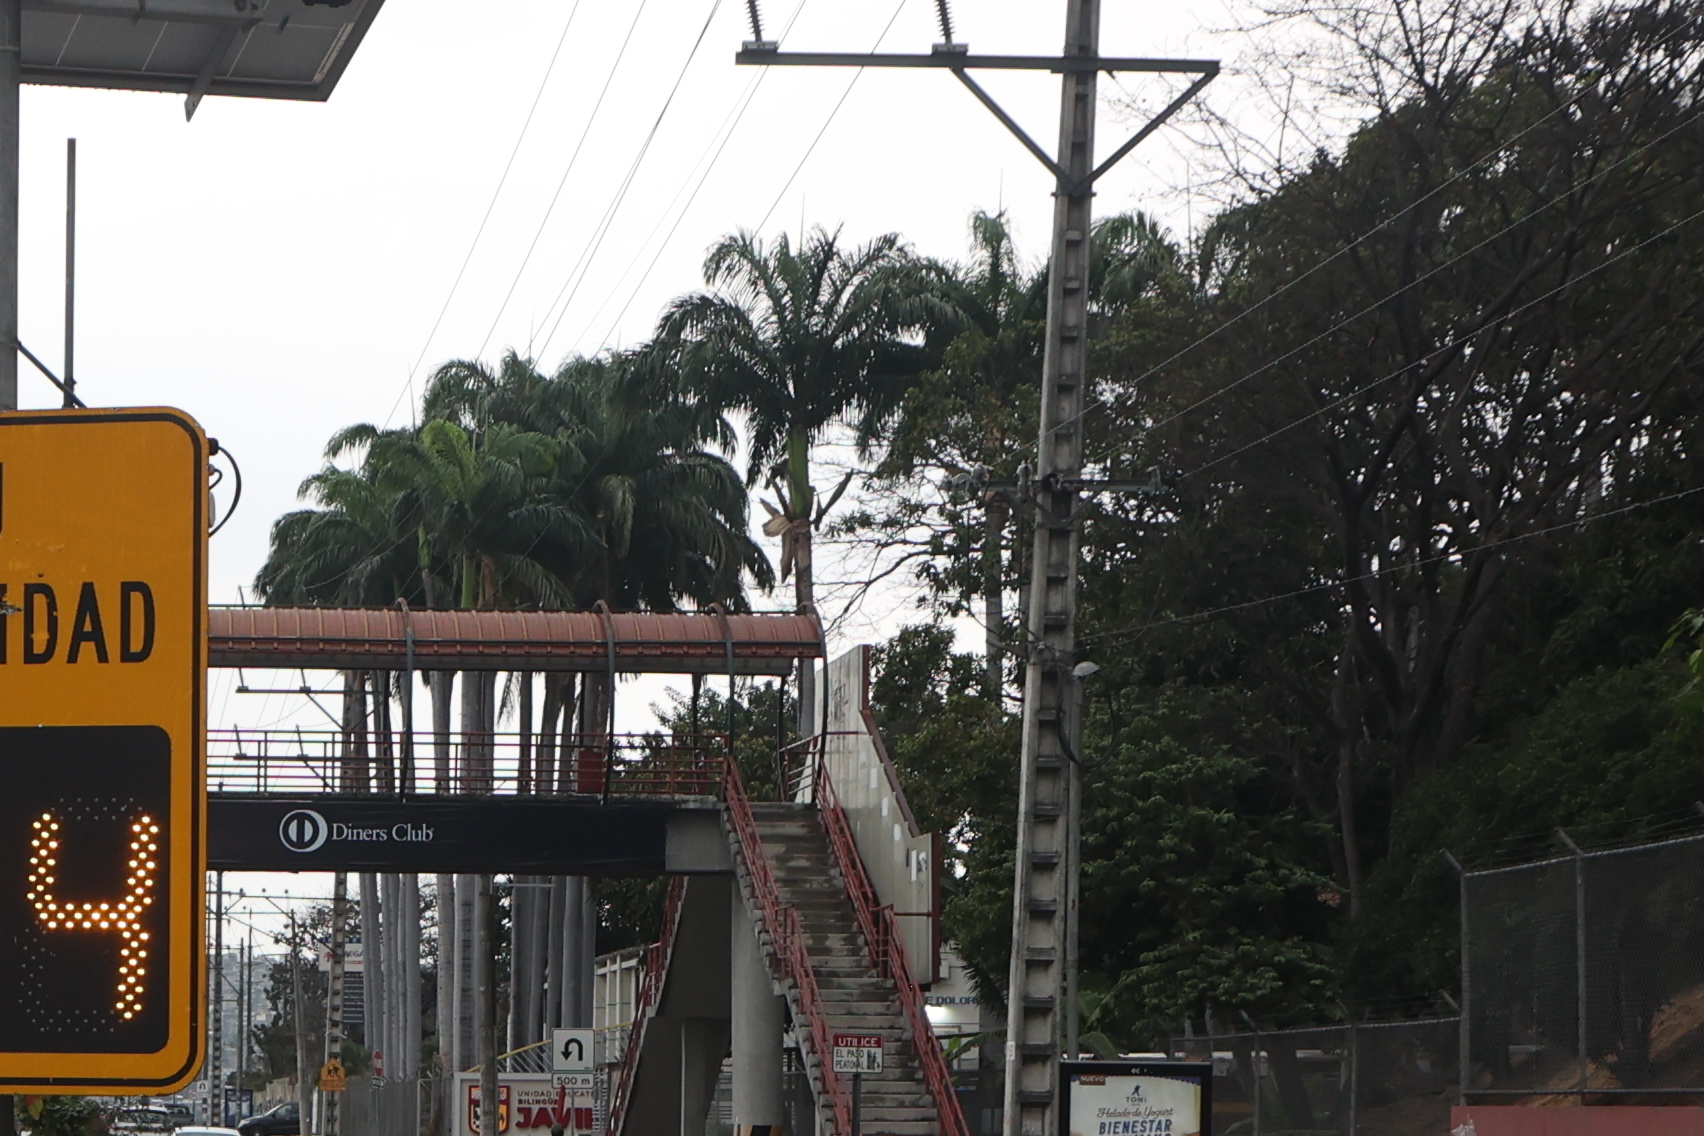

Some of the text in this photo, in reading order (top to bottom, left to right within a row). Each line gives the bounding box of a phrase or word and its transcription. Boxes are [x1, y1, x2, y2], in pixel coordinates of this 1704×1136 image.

[331, 823, 434, 842] Diners Club
[836, 1049, 865, 1058] EL PASO
[556, 1076, 578, 1085] 500
[1097, 1106, 1174, 1120] Helado de Yogurt
[1098, 1119, 1173, 1135] BIENESTAR
